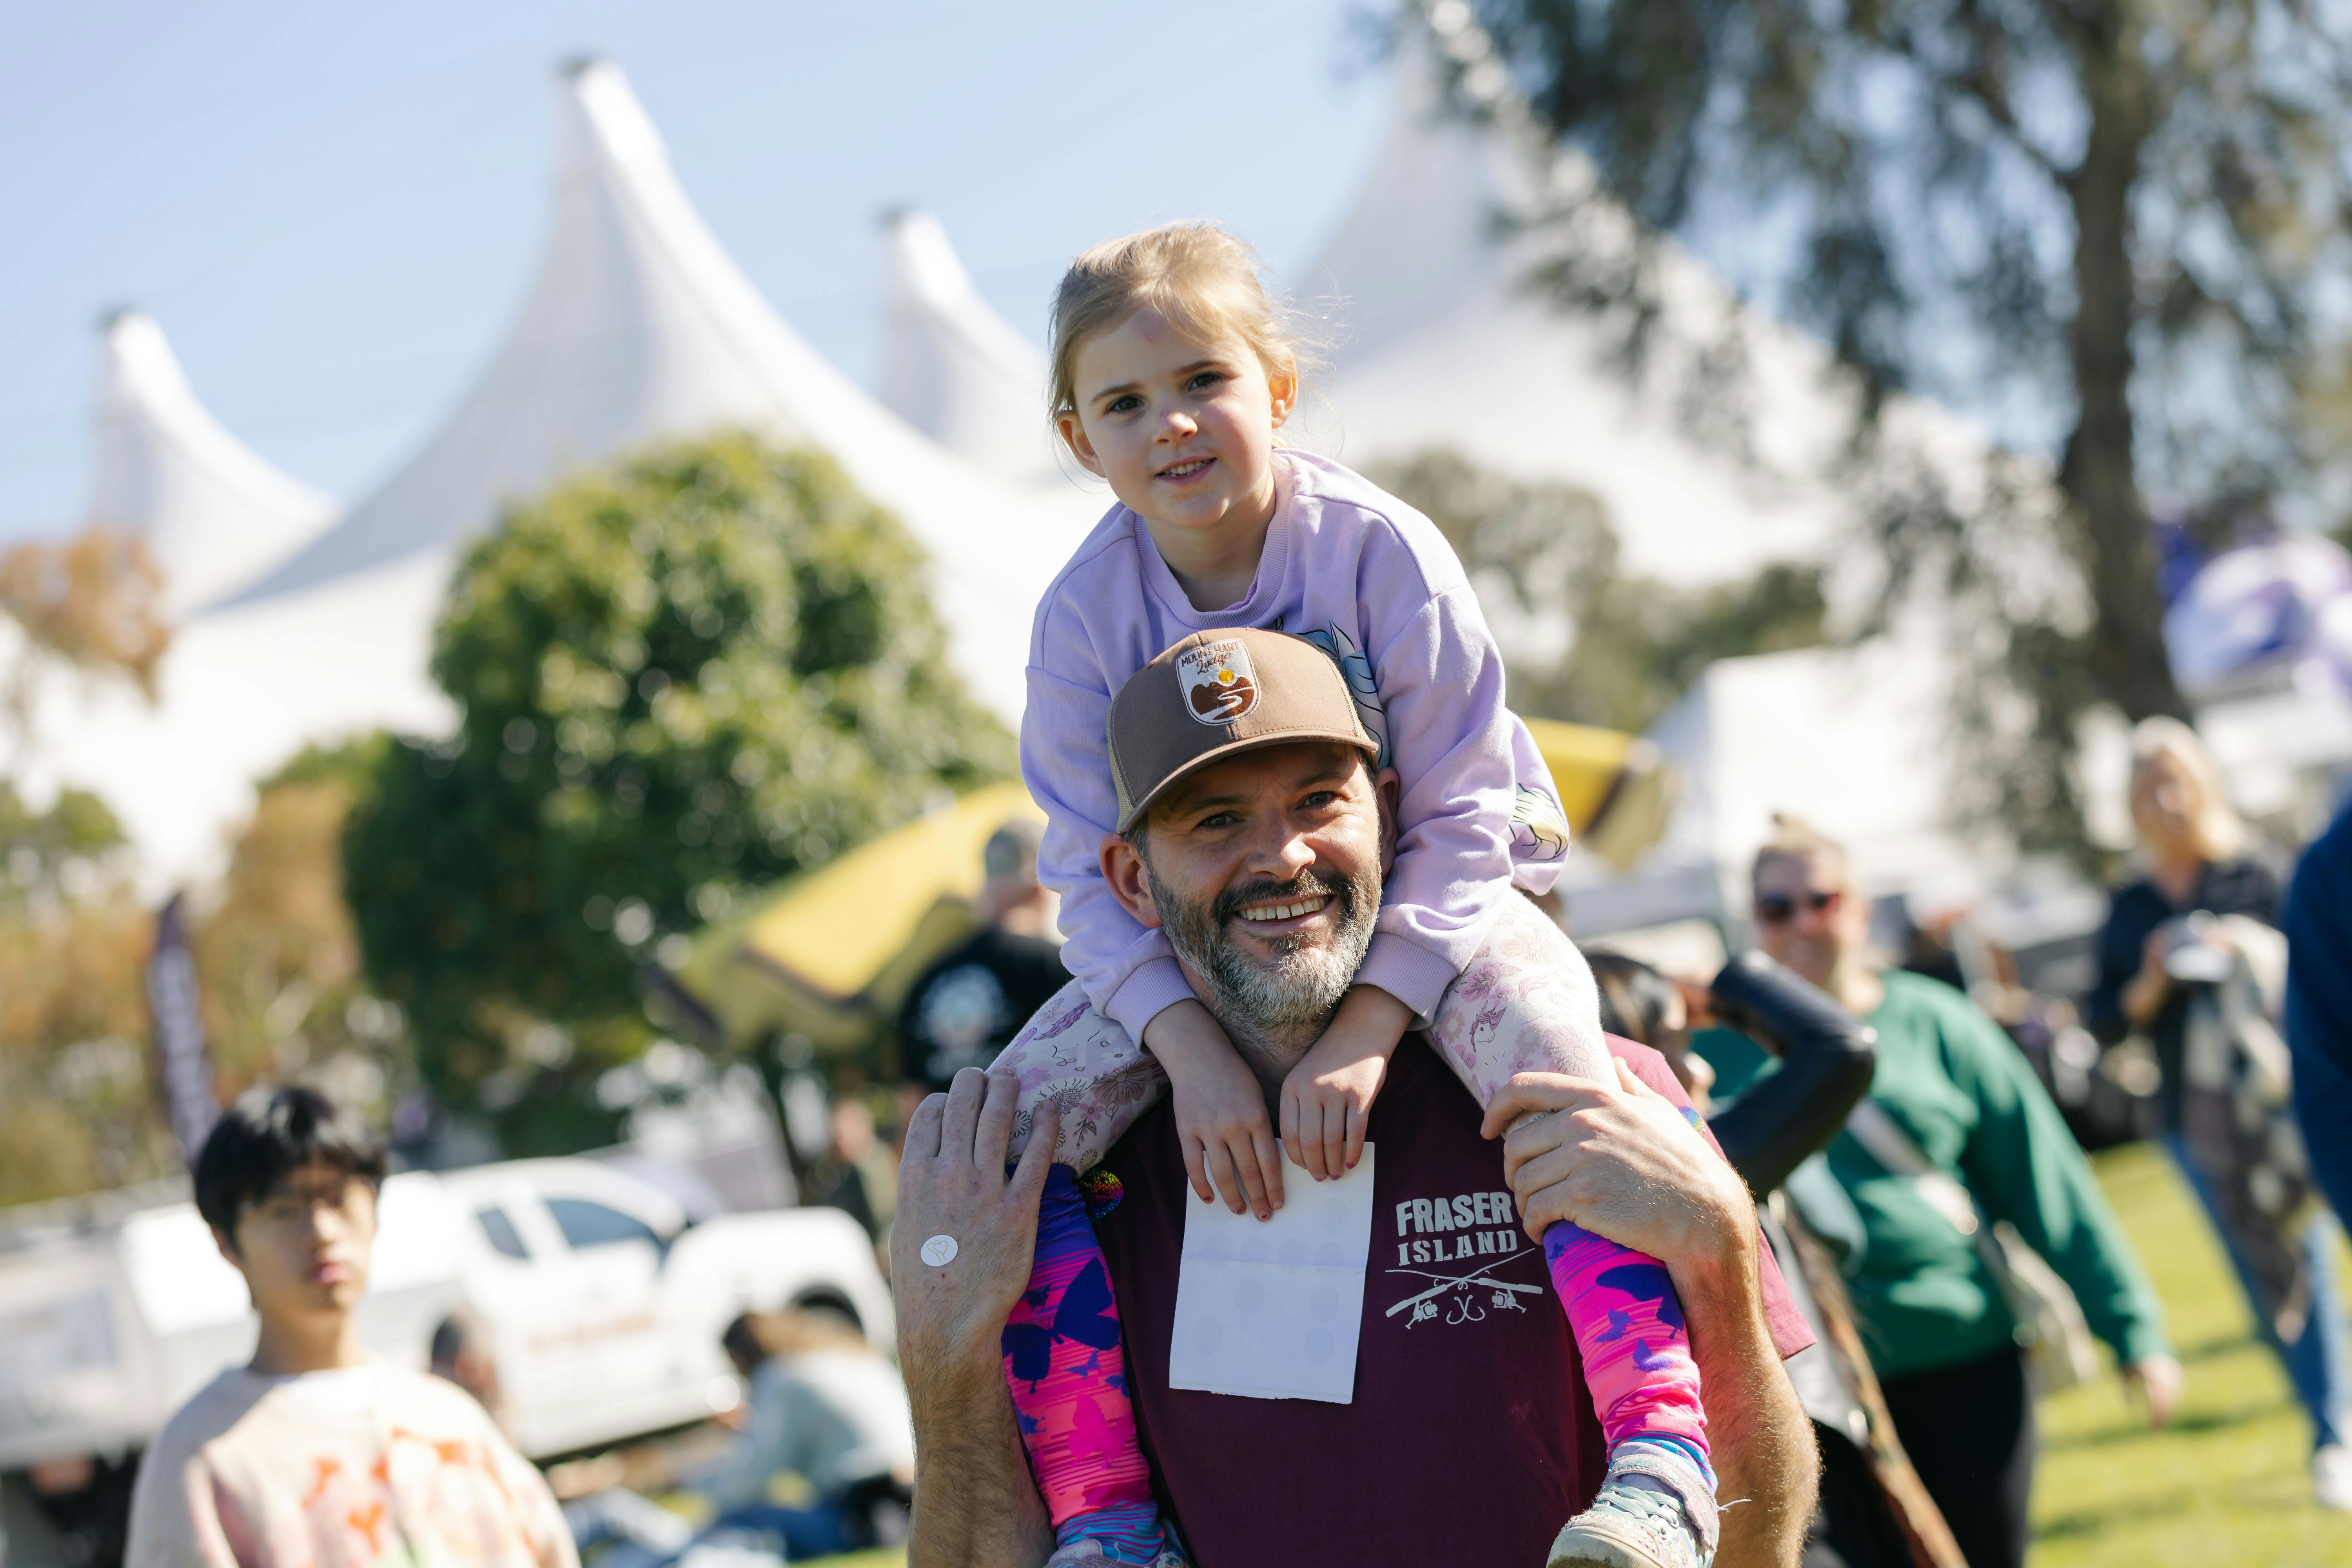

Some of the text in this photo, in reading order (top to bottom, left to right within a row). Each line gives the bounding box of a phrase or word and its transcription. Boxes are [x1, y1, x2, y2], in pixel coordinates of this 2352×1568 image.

[1181, 642, 1239, 667] MOUNT HART
[1396, 1192, 1514, 1236] FRASER
[1398, 1230, 1517, 1266] ISLAND
